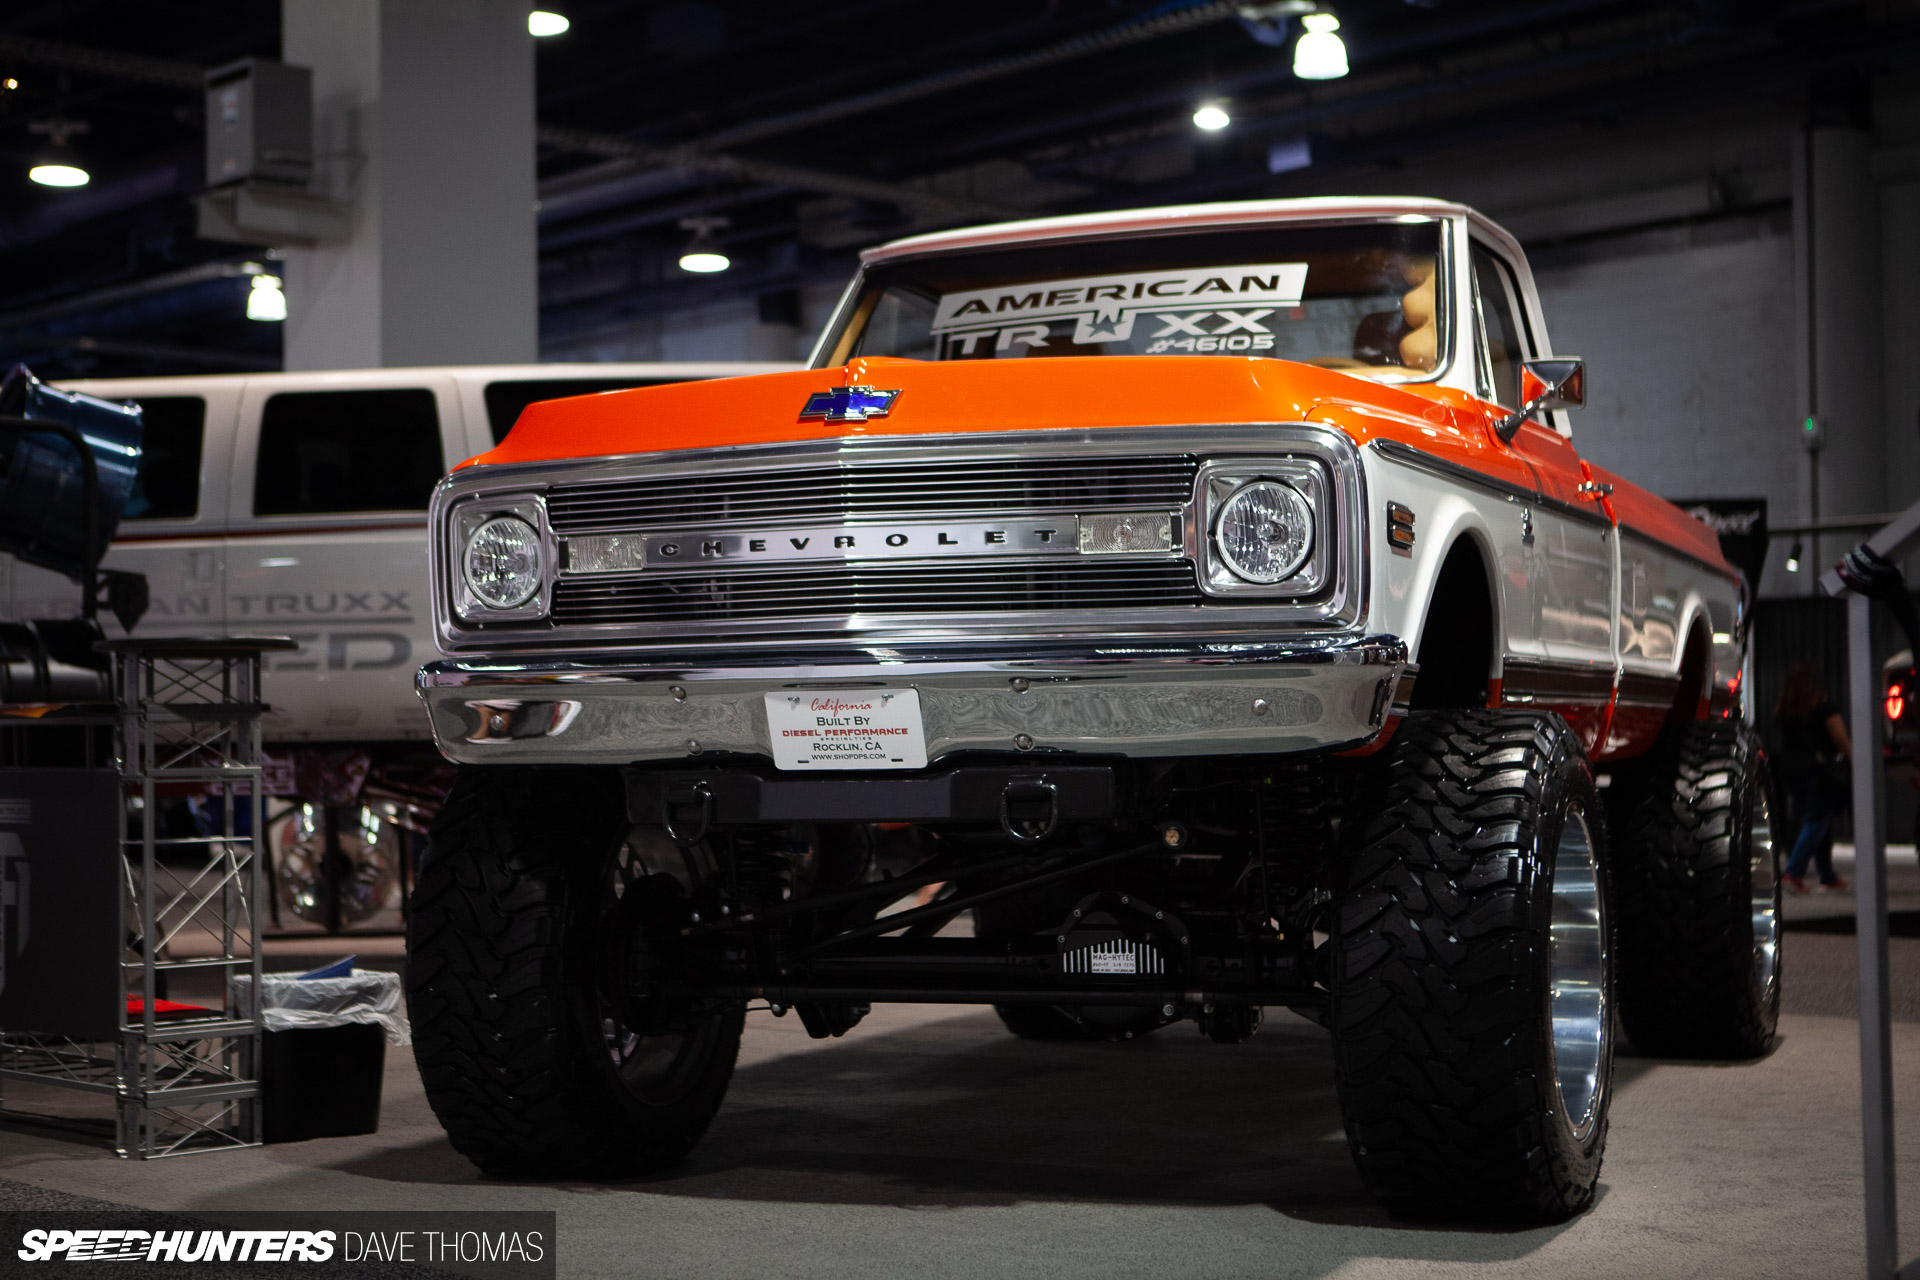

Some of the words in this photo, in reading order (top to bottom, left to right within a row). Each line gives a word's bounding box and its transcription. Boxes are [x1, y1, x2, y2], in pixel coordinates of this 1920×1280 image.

[949, 274, 1282, 319] AMERICAN
[1146, 334, 1276, 354] #46105
[660, 529, 1058, 557] CHEVROLET
[229, 592, 411, 616] TRUXX
[810, 697, 872, 717] California
[782, 729, 822, 737] DIESEL
[825, 727, 908, 737] PERFORMANCE
[865, 741, 882, 751] CA
